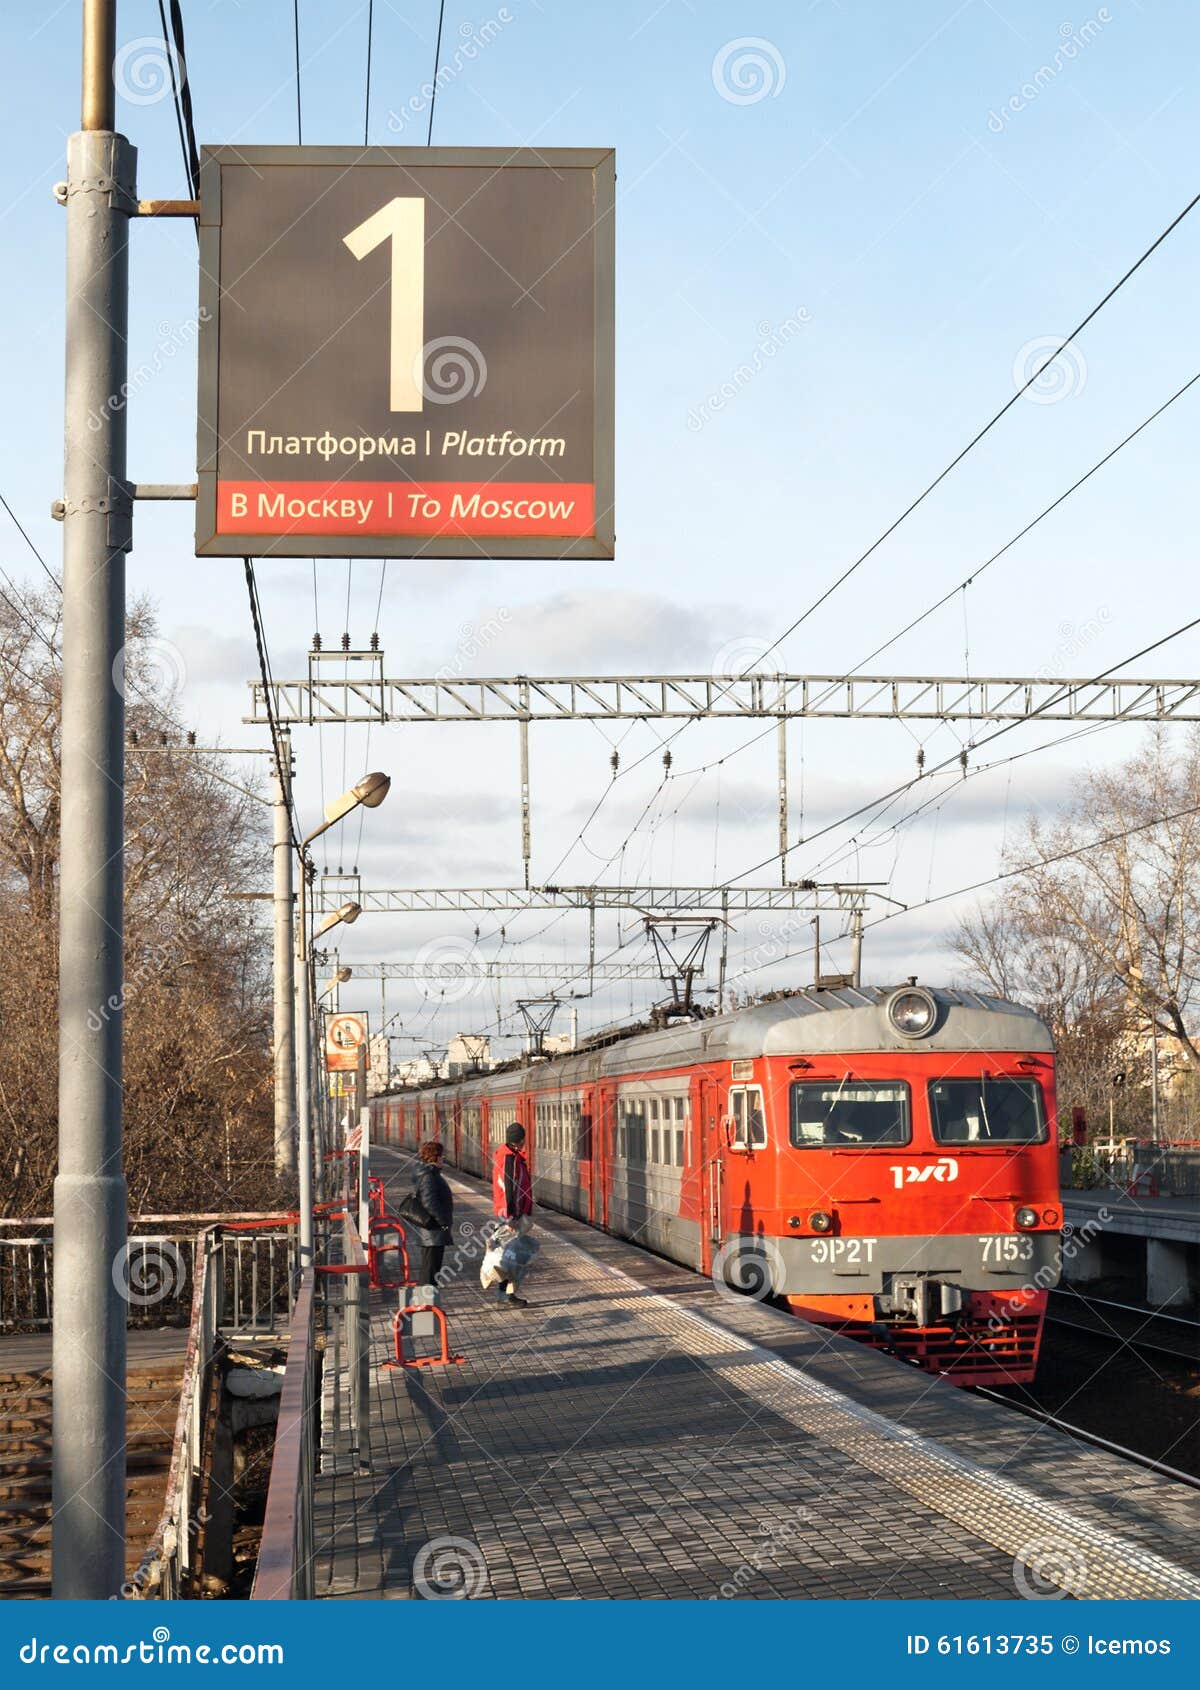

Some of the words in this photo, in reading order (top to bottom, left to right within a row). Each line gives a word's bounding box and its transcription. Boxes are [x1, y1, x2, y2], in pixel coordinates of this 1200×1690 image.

[343, 197, 425, 412] 1
[247, 430, 417, 461] Платформа
[441, 430, 567, 458] Platform
[231, 493, 248, 518] В
[257, 493, 374, 524] Москву
[408, 494, 442, 518] To
[450, 494, 575, 519] Moscow
[810, 1239, 877, 1263] ЭР2Т
[979, 1237, 1034, 1262] 7153
